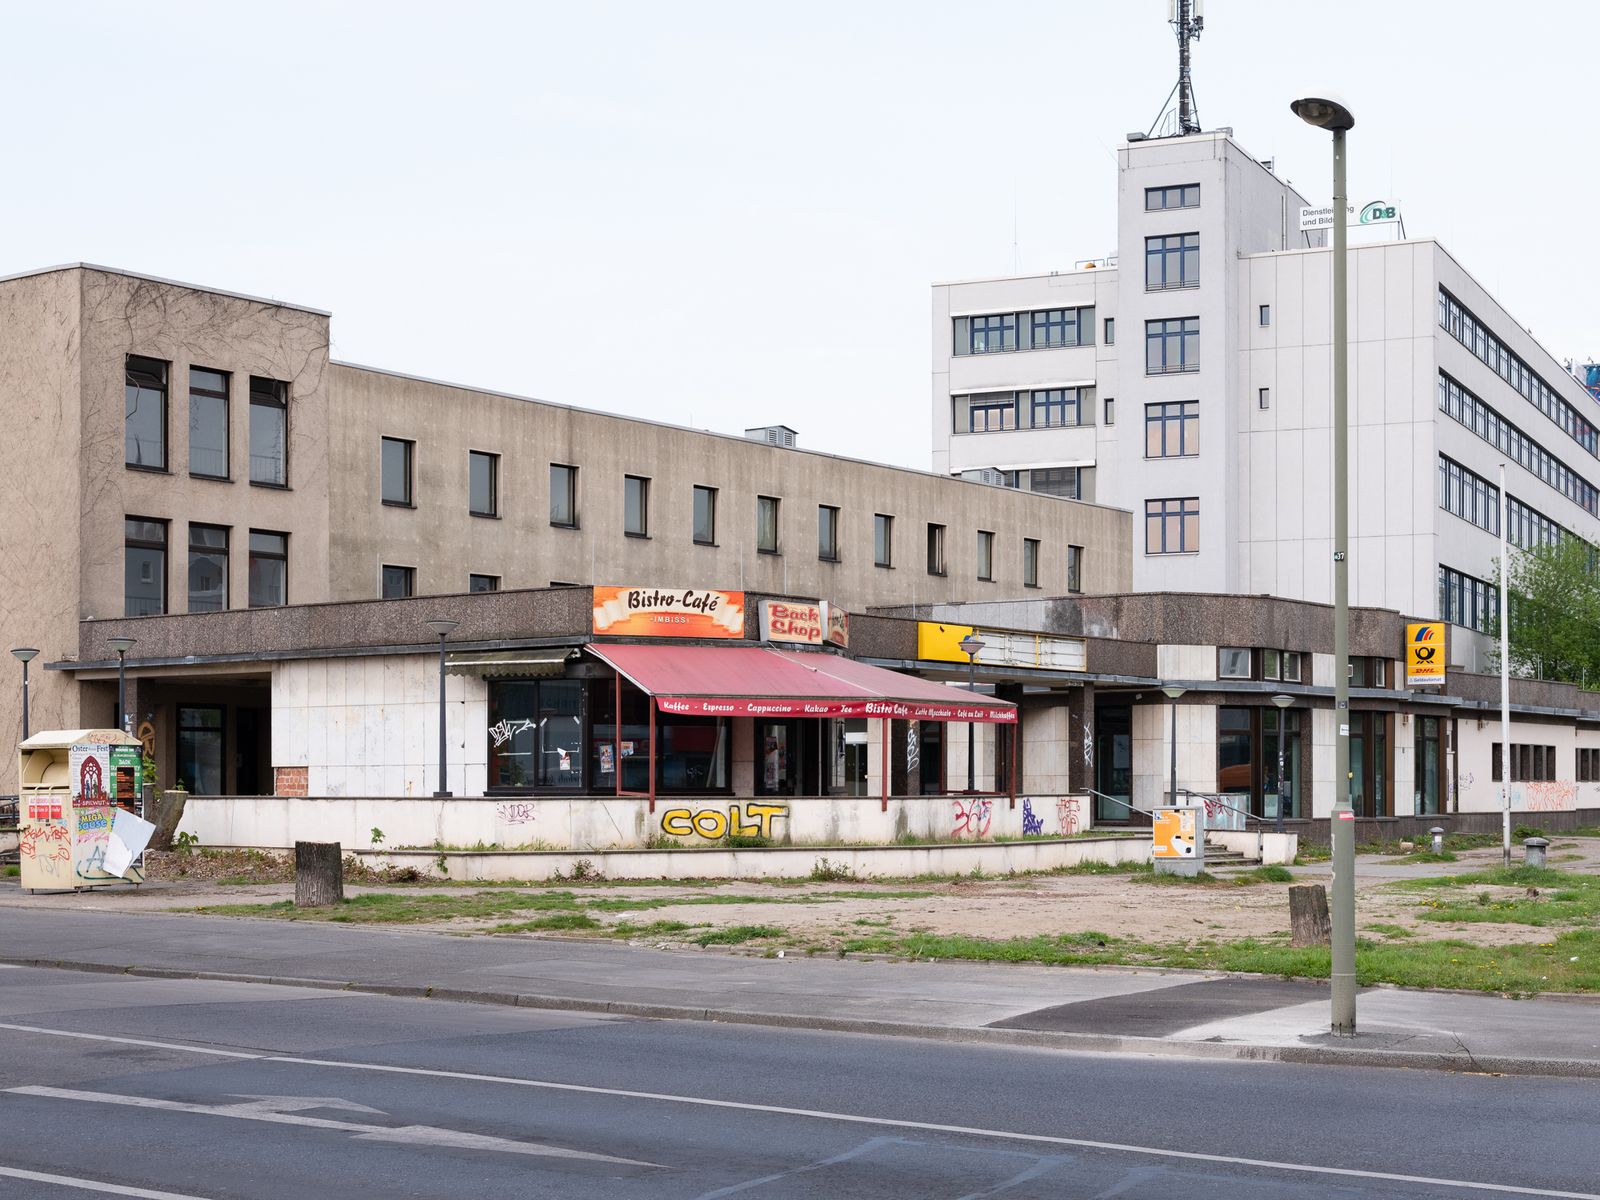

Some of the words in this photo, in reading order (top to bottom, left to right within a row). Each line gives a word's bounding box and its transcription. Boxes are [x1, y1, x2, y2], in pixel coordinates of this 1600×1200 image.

[1302, 218, 1317, 226] und
[628, 590, 720, 613] Bistro-Café
[768, 603, 819, 622] Back
[771, 620, 821, 641] Shop
[663, 701, 689, 711] Kaffee
[703, 702, 735, 712] Espresso
[747, 703, 792, 713] Cappuccino
[804, 704, 829, 713] Kakao
[840, 704, 852, 713] Tee
[865, 702, 892, 714] Bistro
[661, 803, 789, 839] COLT
